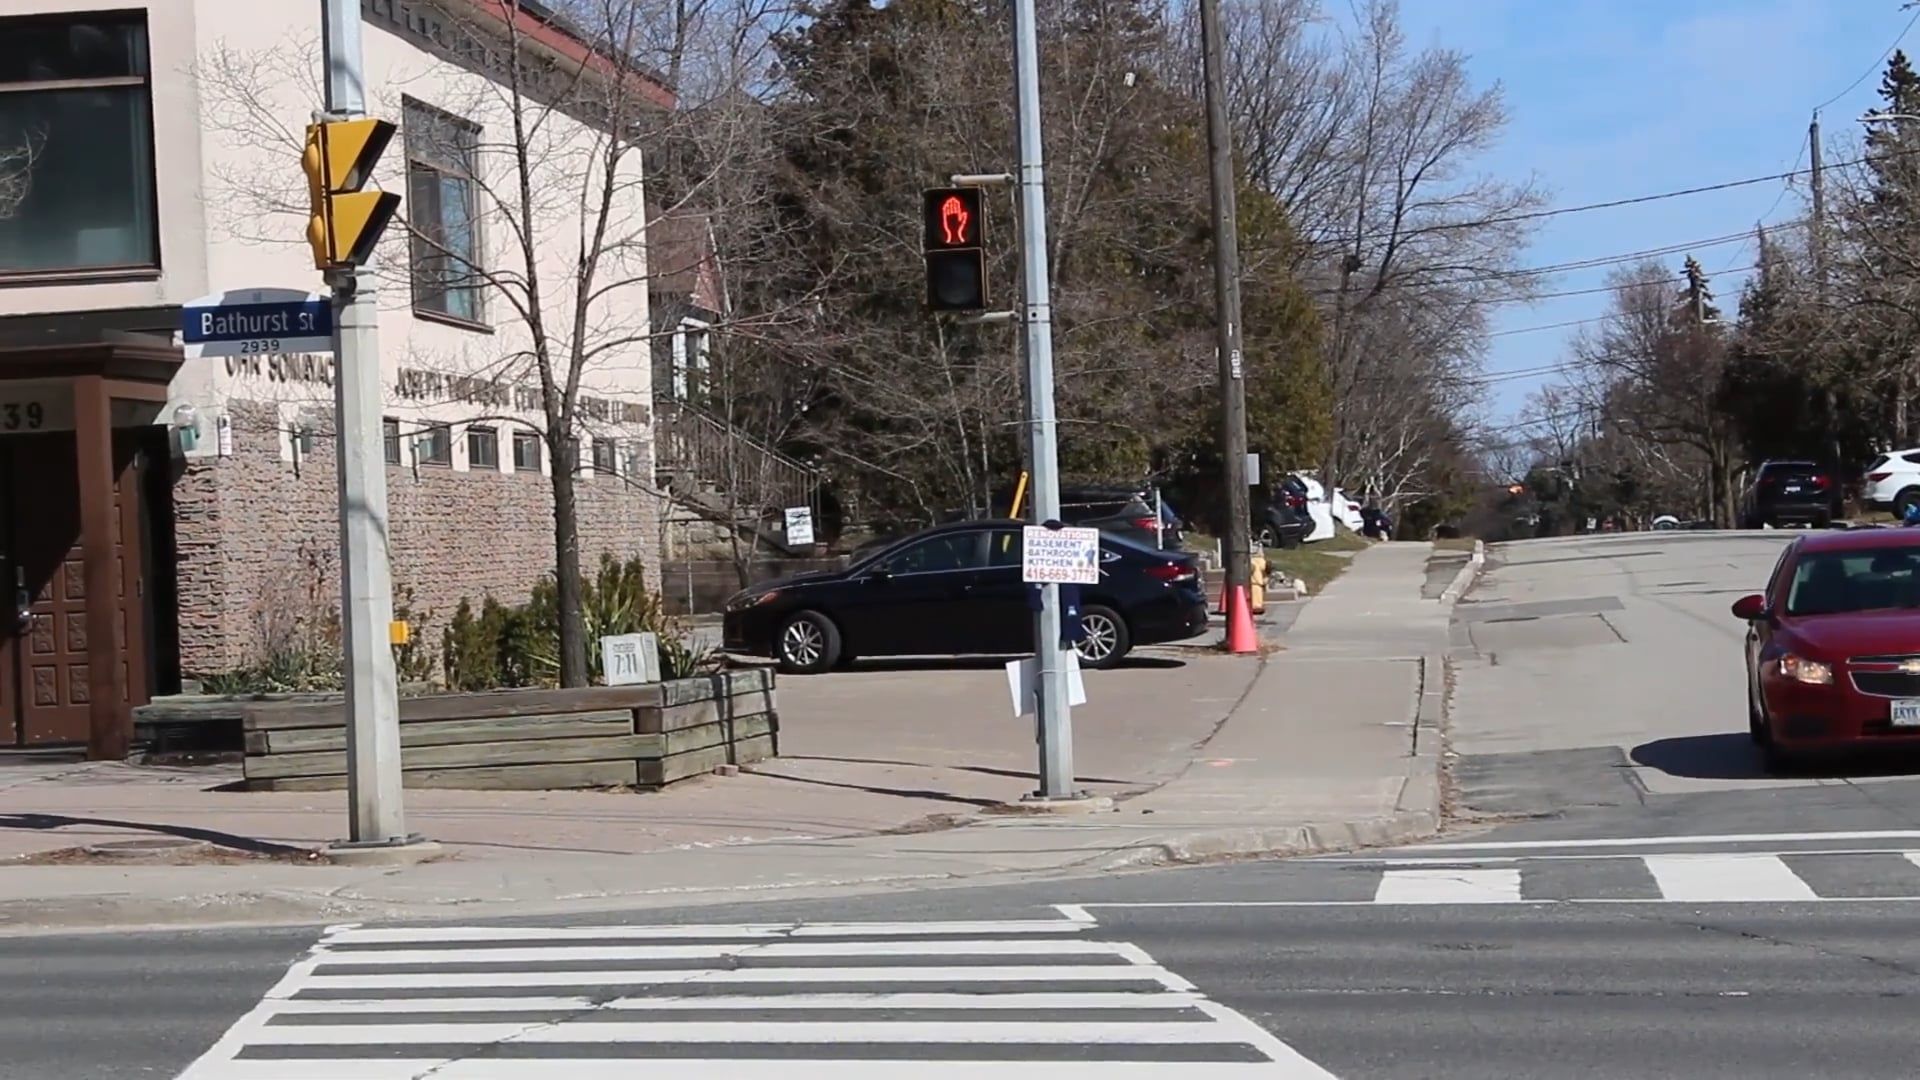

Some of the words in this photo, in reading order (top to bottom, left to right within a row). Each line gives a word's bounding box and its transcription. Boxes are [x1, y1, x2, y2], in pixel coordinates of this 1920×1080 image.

[201, 311, 288, 335] Bathurst
[298, 312, 314, 331] St
[241, 339, 280, 353] 2939
[1027, 530, 1096, 540] RENOVATIONS
[1028, 540, 1082, 549] BASEMENT
[1028, 549, 1080, 558] BATHROOM
[1028, 559, 1073, 567] KITCHEN
[1026, 568, 1096, 582] 416-669-3779
